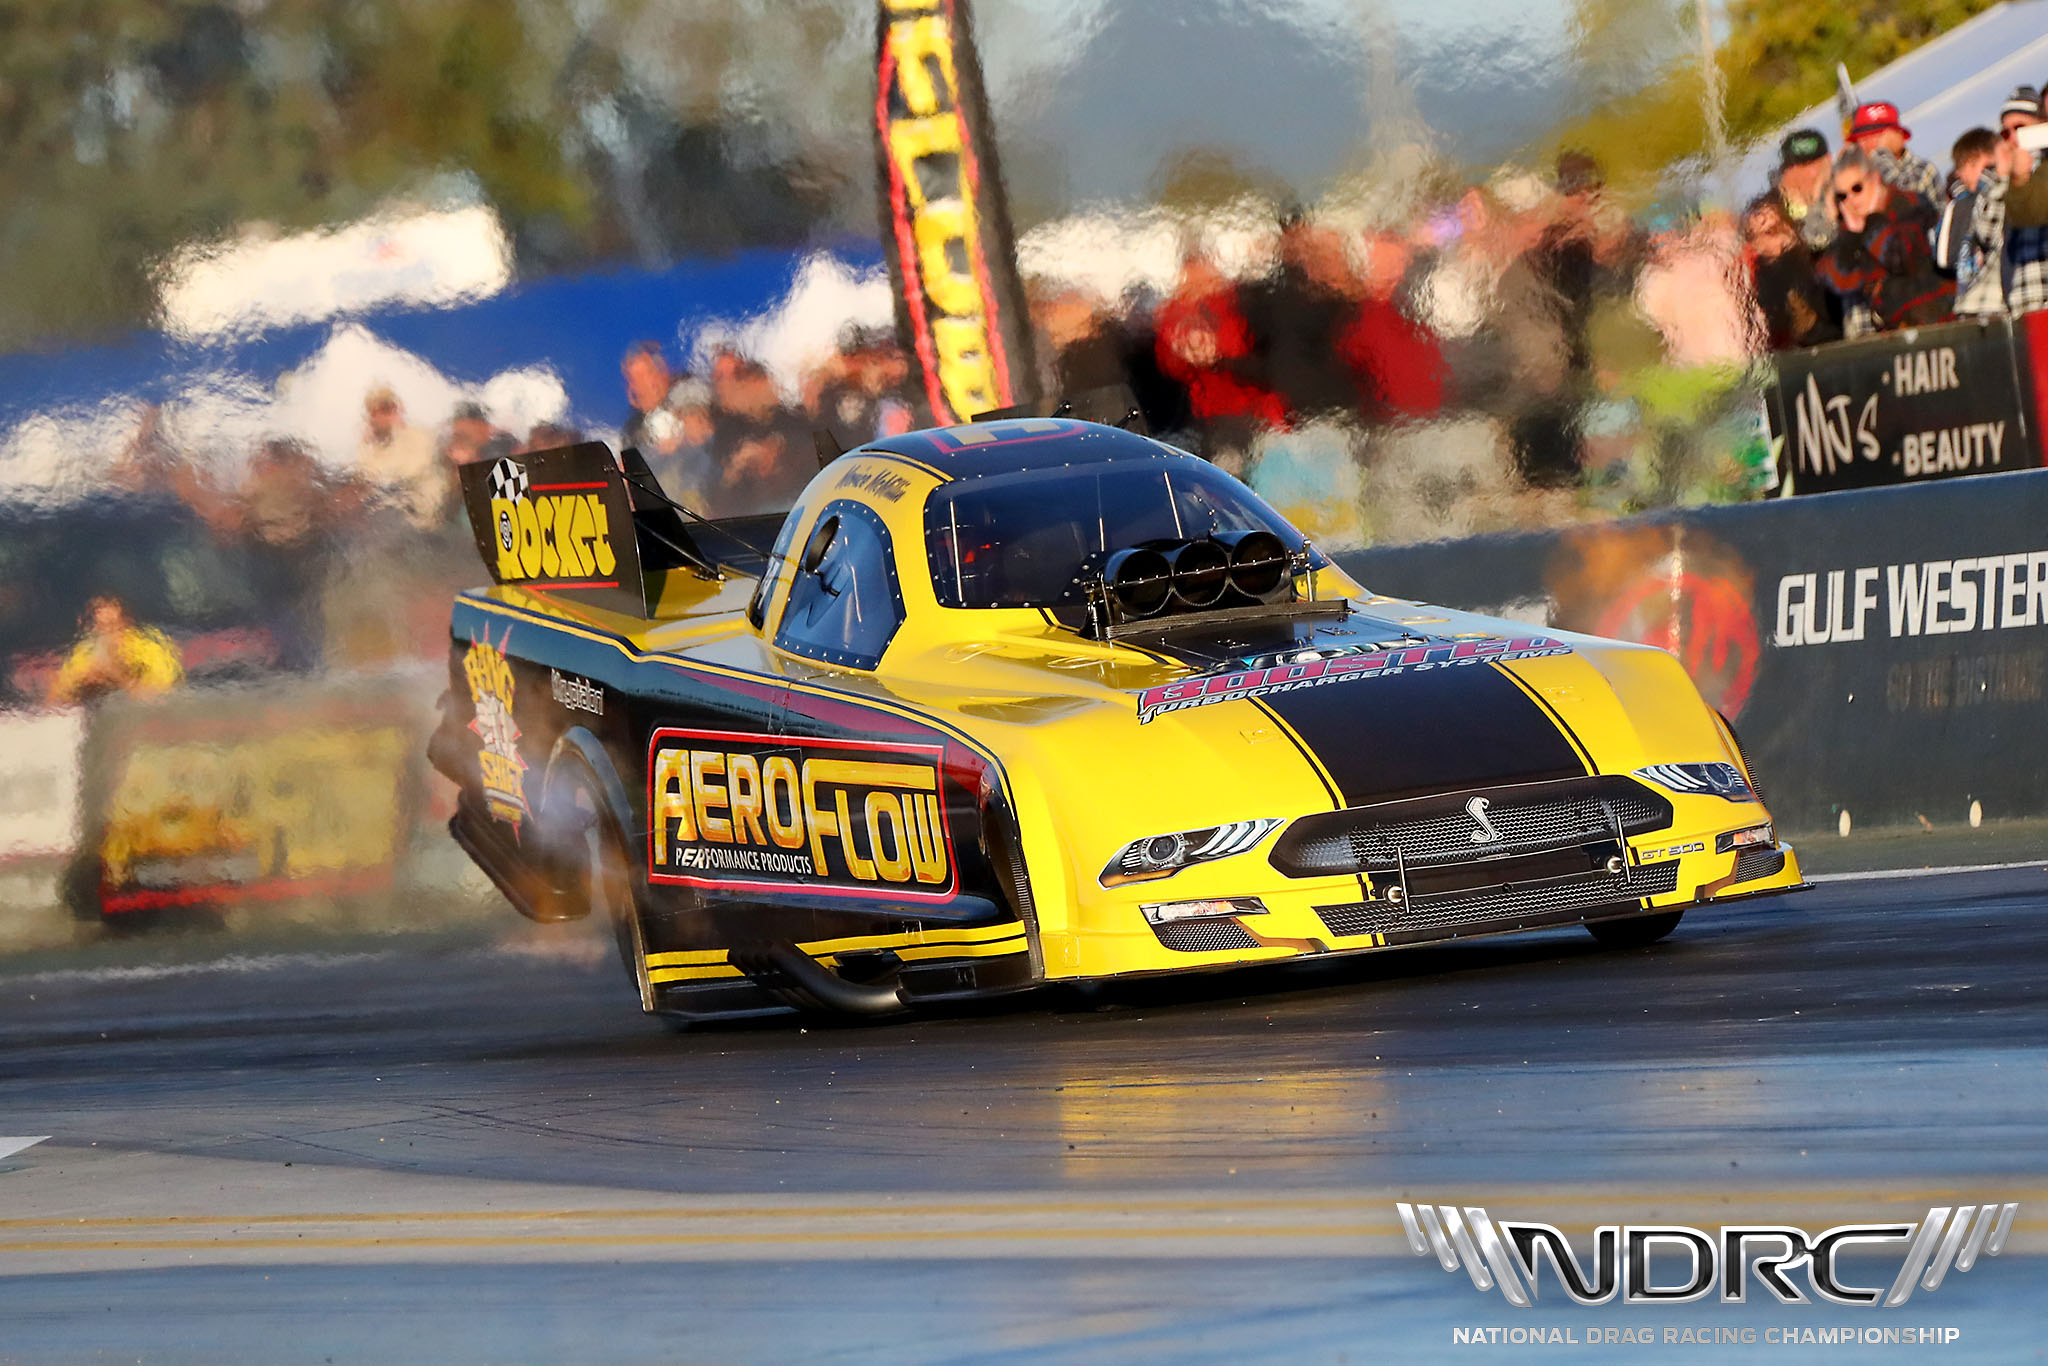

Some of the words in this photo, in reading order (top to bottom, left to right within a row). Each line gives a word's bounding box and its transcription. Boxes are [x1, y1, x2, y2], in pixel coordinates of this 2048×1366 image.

[889, 0, 1002, 424] FLOW
[1894, 347, 1959, 397] HAIR
[1902, 420, 2006, 476] BEAUTY
[1776, 566, 1879, 647] GULF
[1887, 551, 2048, 638] WESTER
[1136, 637, 1574, 715] BOOSTED
[1139, 665, 1406, 725] TURBOCHARGER
[1413, 648, 1573, 673] SYSTEMS
[655, 748, 947, 884] AEROFLOW
[1641, 848, 1666, 860] GT
[1668, 841, 1705, 856] 500
[675, 847, 761, 871] PERFORMANCE
[760, 852, 813, 875] PRODUCTS
